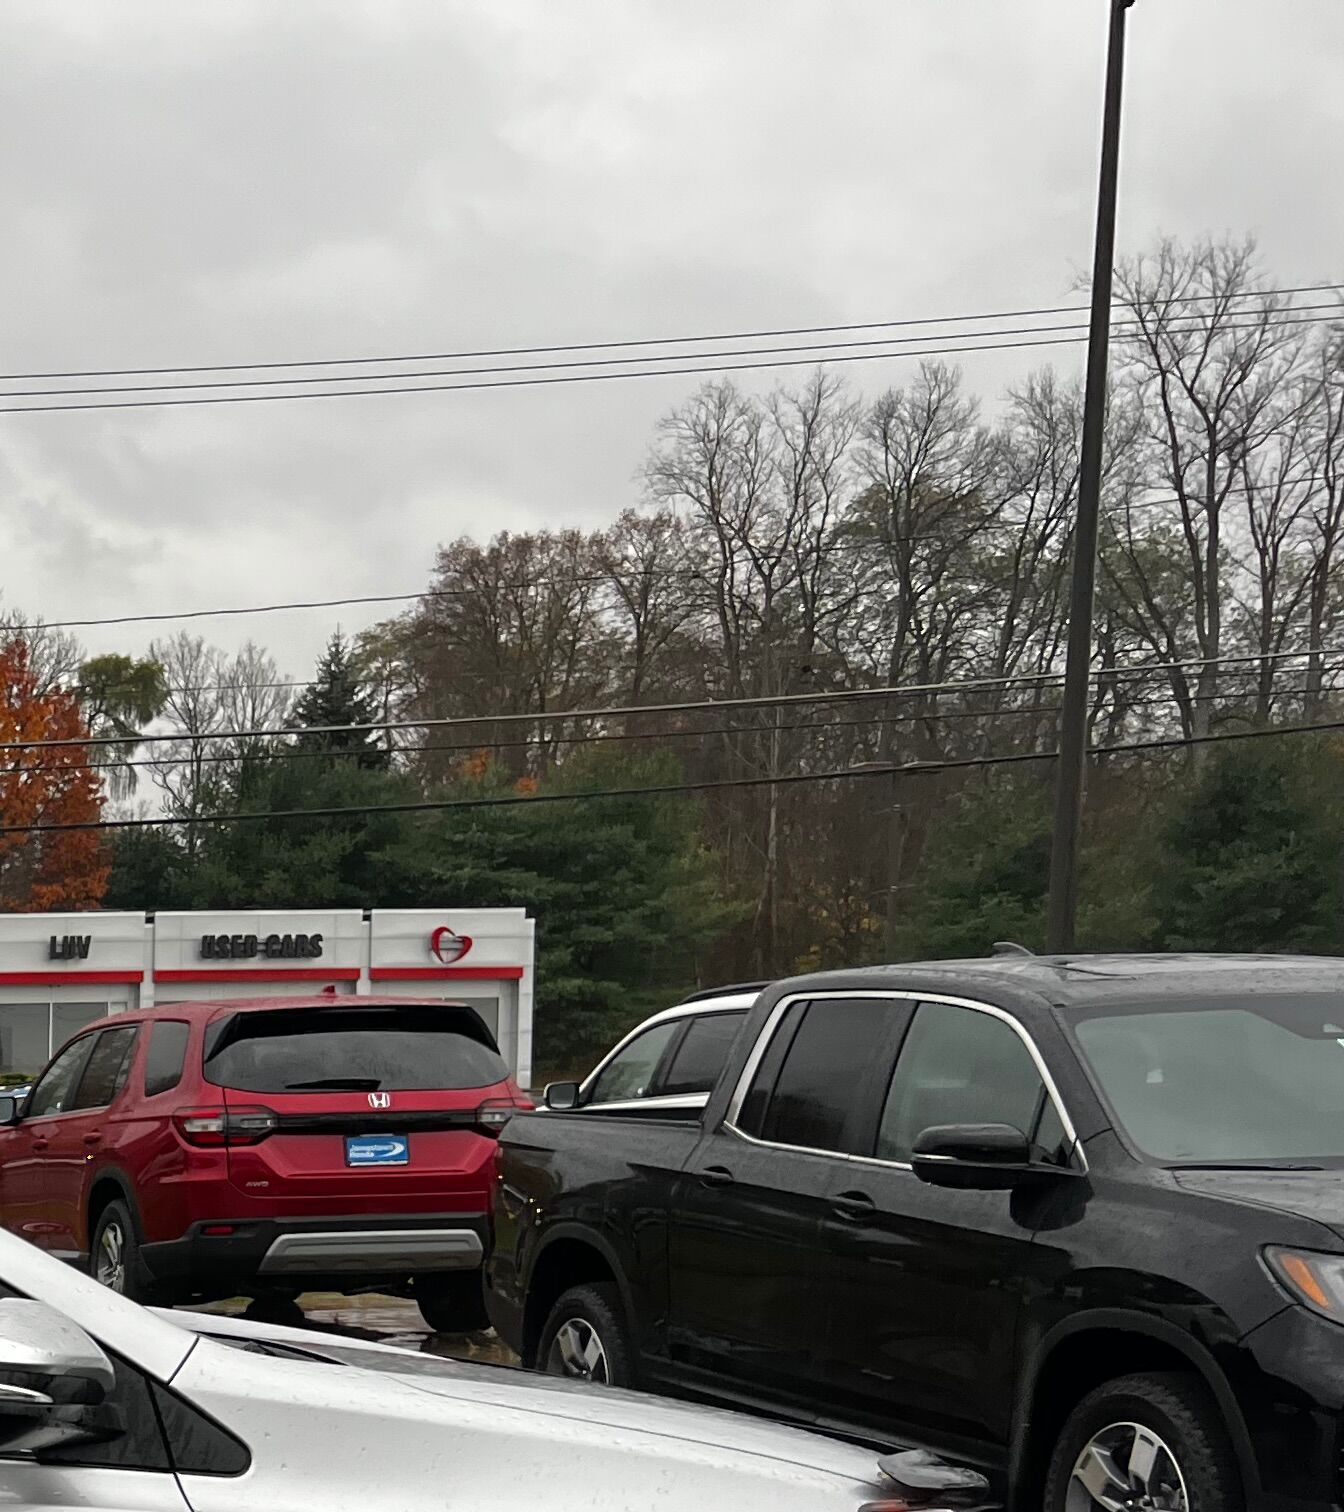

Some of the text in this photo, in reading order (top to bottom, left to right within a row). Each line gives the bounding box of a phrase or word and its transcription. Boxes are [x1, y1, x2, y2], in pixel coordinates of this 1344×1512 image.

[48, 934, 92, 960] LUV
[201, 934, 323, 959] USED CARS
